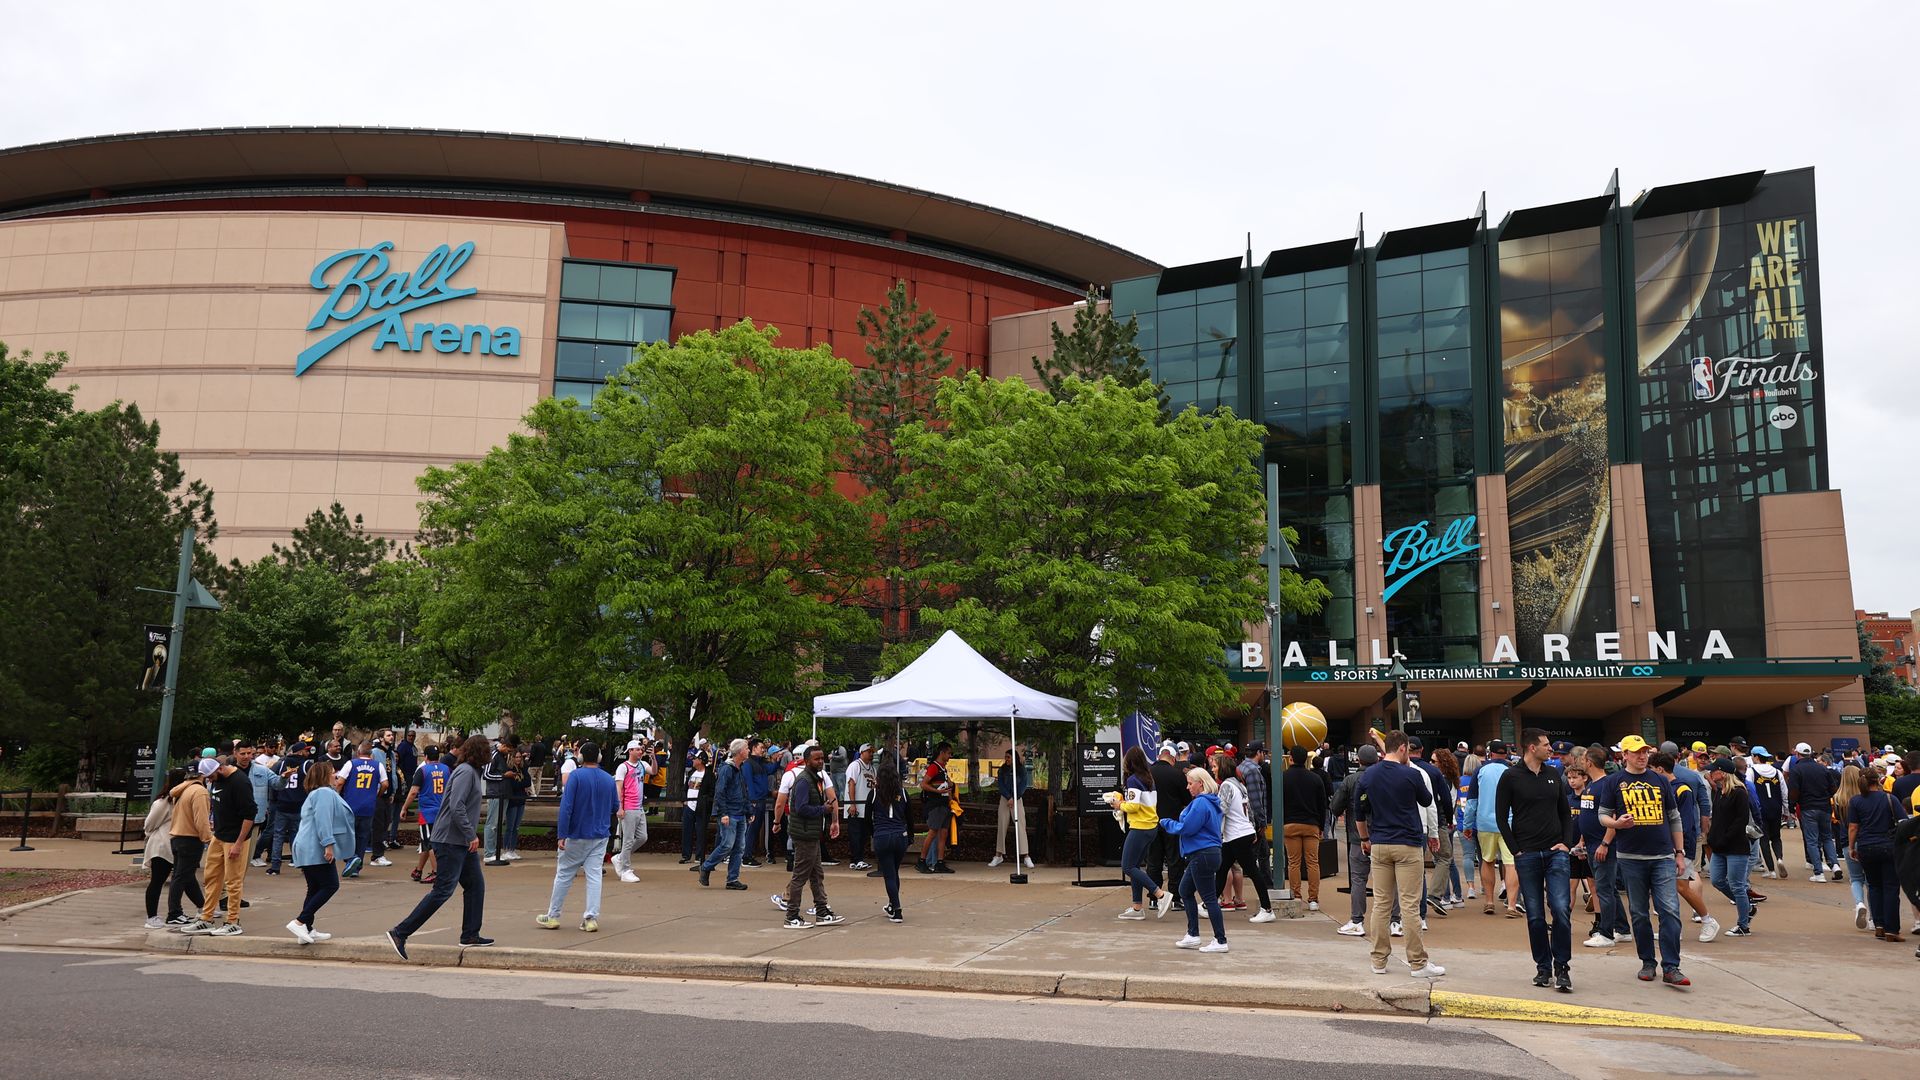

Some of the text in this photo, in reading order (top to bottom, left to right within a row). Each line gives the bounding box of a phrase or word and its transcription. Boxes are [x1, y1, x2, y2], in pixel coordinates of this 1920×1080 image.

[1756, 219, 1797, 255] WE
[1749, 255, 1801, 289] ARE
[296, 241, 477, 377] Ball
[1753, 289, 1806, 323] ALL
[372, 313, 520, 356] Arena
[1763, 322, 1805, 340] IN THE
[1705, 352, 1818, 404] Finals
[1772, 412, 1796, 422] abc
[1383, 515, 1481, 604] Ball
[1242, 629, 1734, 668] BALL ARENA
[1334, 665, 1624, 681] SPORTS NTERTAINMENT SUSTAINABILITY
[356, 772, 373, 788] 27
[433, 778, 444, 794] 15
[1764, 782, 1772, 799] 1
[1621, 788, 1662, 805] MILE
[1626, 803, 1664, 820] HIGH
